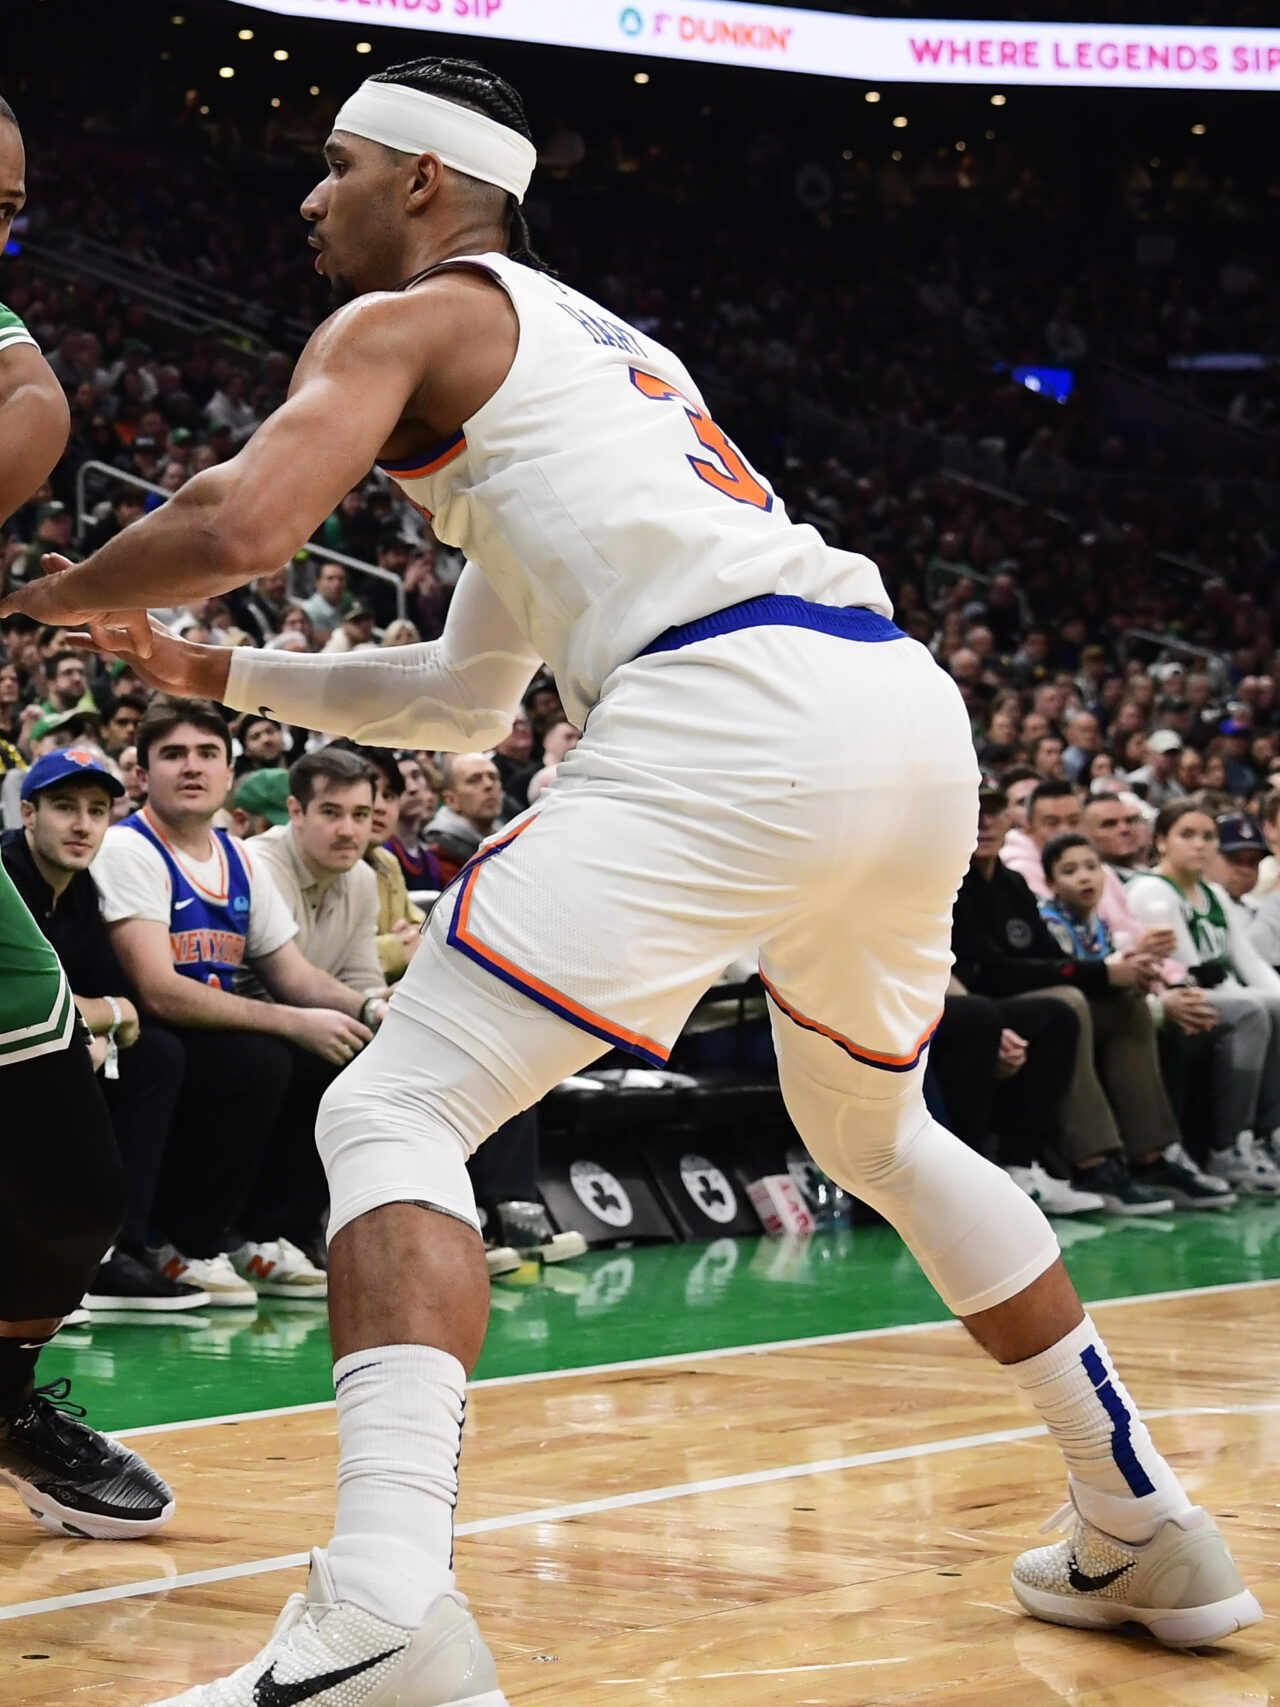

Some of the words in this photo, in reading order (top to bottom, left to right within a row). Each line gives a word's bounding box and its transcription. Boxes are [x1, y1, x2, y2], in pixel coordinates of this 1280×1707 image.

[909, 39, 1040, 67] WHERE
[1053, 42, 1219, 72] LEGENDS
[628, 365, 774, 514] 3
